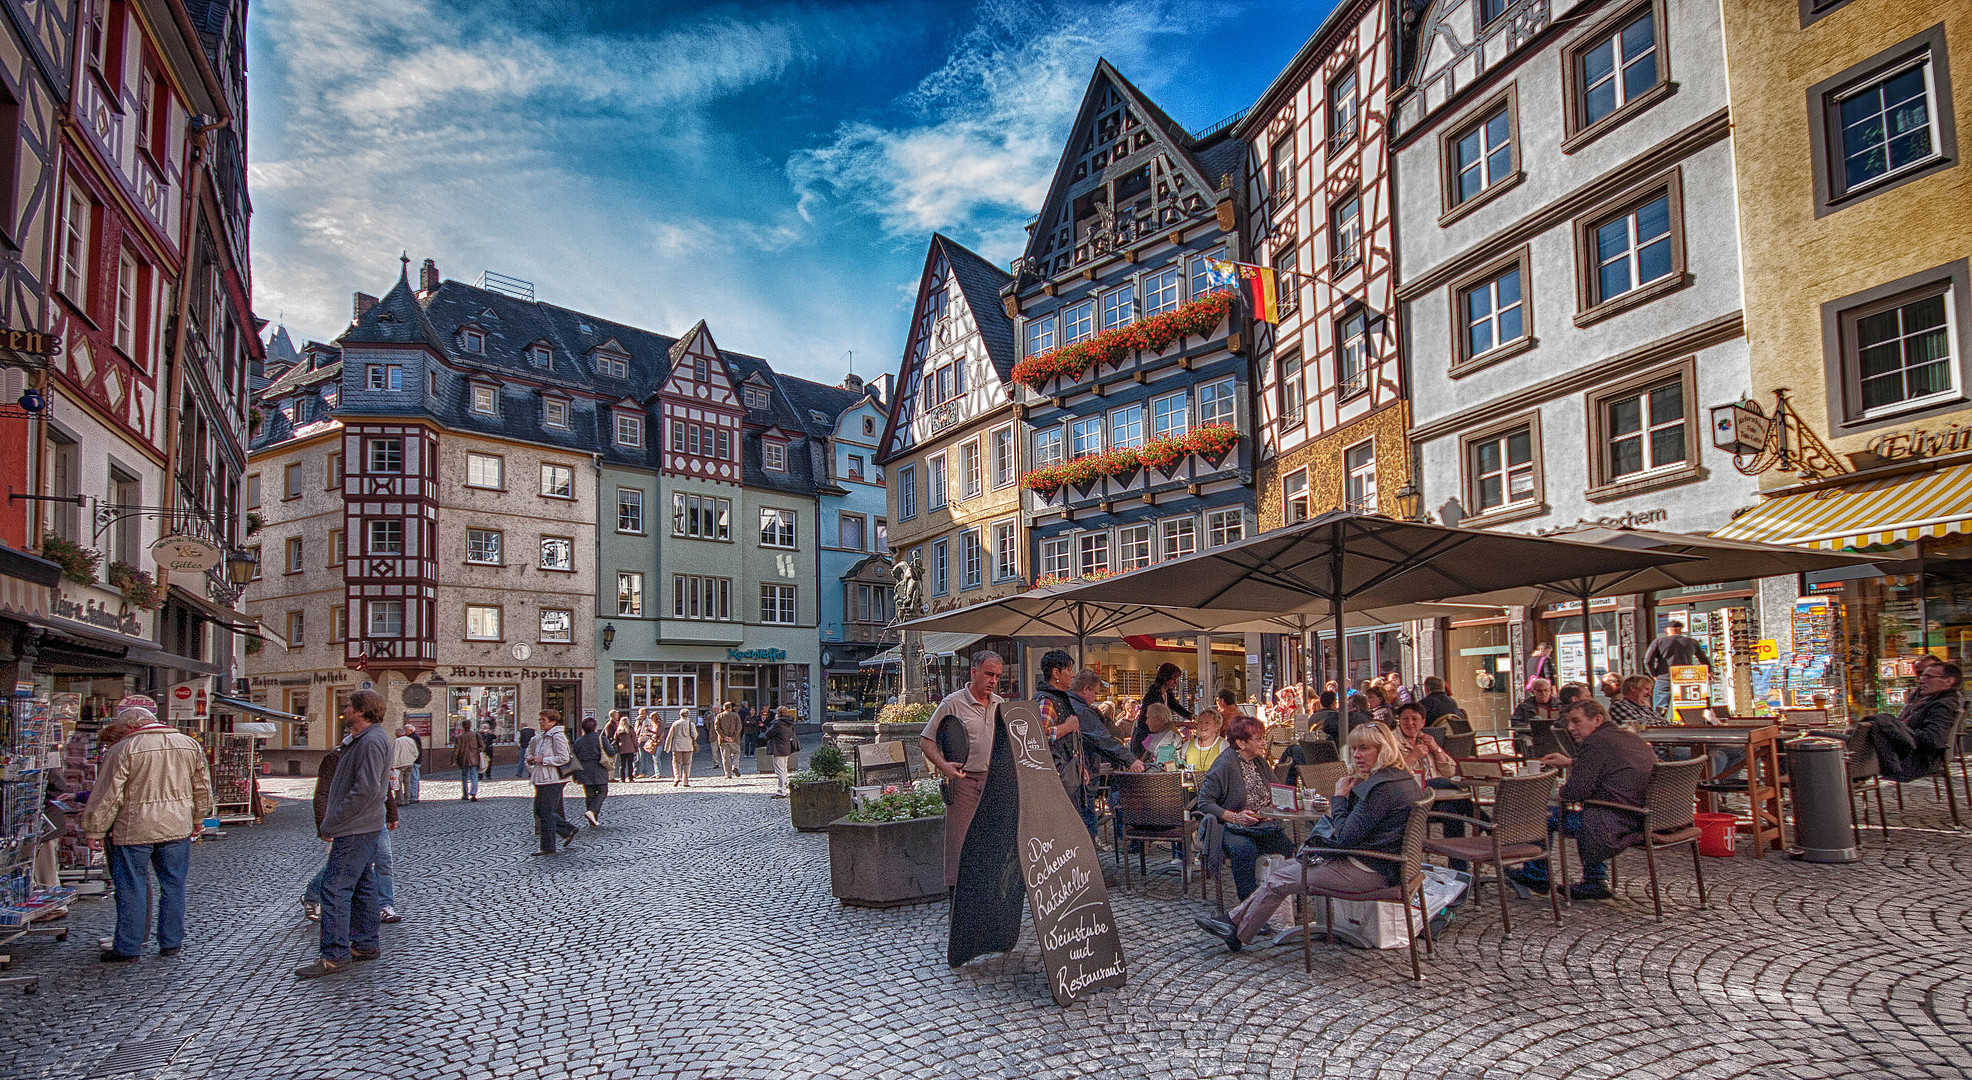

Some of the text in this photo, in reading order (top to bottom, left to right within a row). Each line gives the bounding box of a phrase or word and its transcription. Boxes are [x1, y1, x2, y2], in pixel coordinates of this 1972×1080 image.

[170, 560, 202, 570] Gilles
[313, 671, 347, 684] Apotheke
[1028, 837, 1055, 863] Der
[1028, 846, 1079, 889] Cochemer
[1034, 866, 1091, 921] Ratskeller
[1044, 913, 1109, 951] Weinstube
[1069, 938, 1095, 961] und
[1056, 952, 1126, 999] Restaurant
